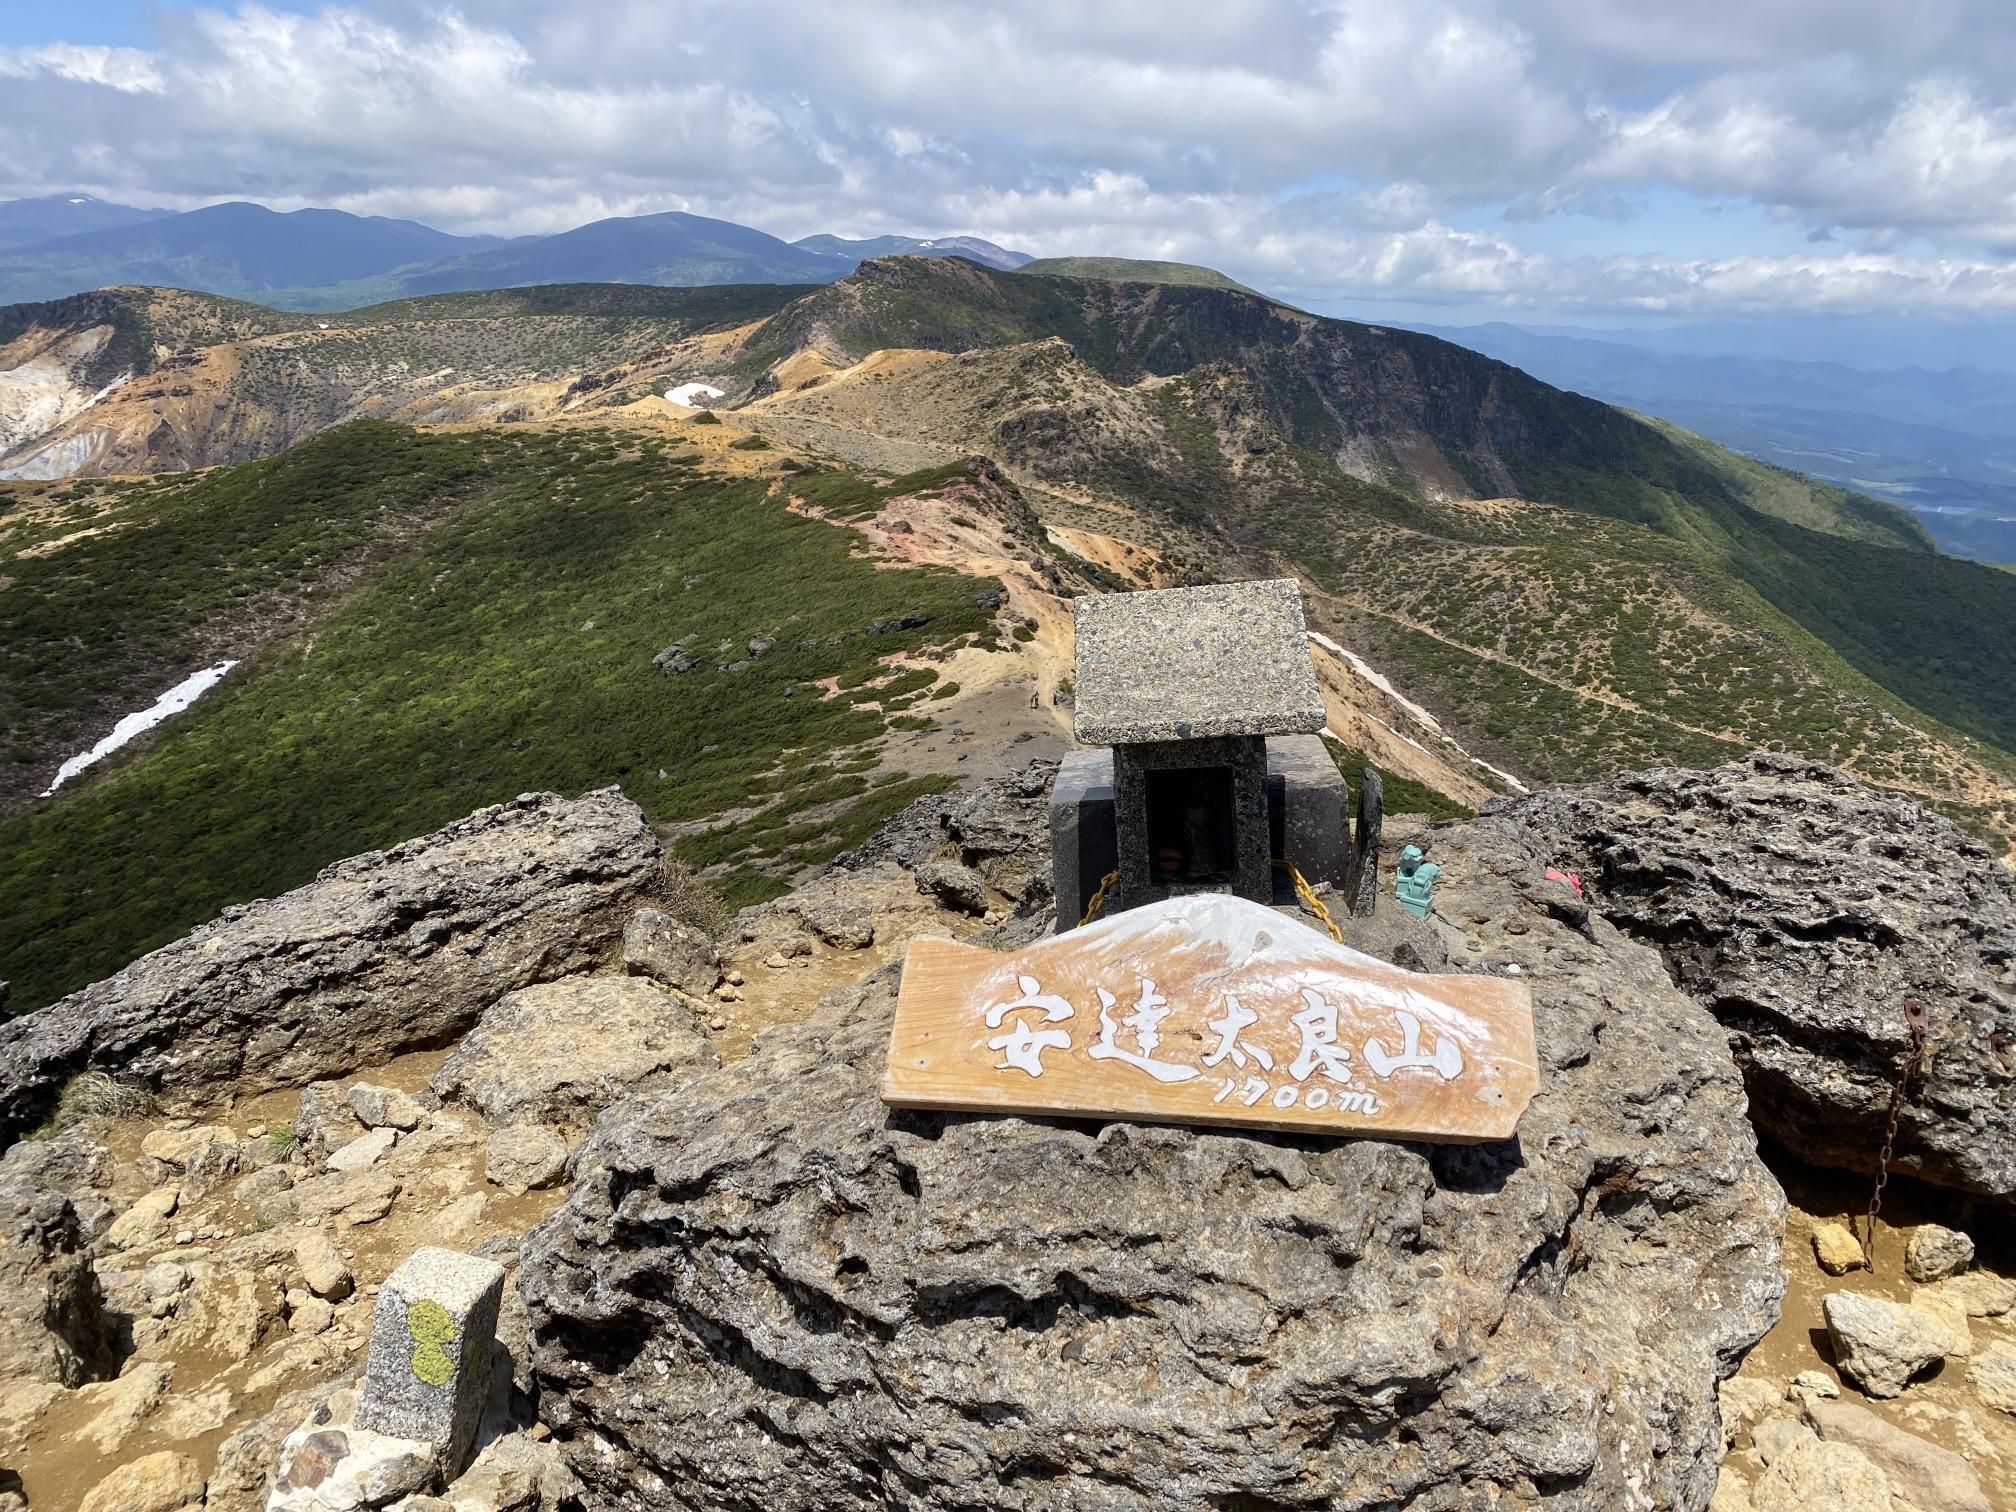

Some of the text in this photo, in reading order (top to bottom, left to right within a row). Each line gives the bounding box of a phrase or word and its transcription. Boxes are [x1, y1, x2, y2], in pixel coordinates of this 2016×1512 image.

[984, 975, 1464, 1083] 安達太良山
[1212, 1076, 1381, 1115] 1700m
